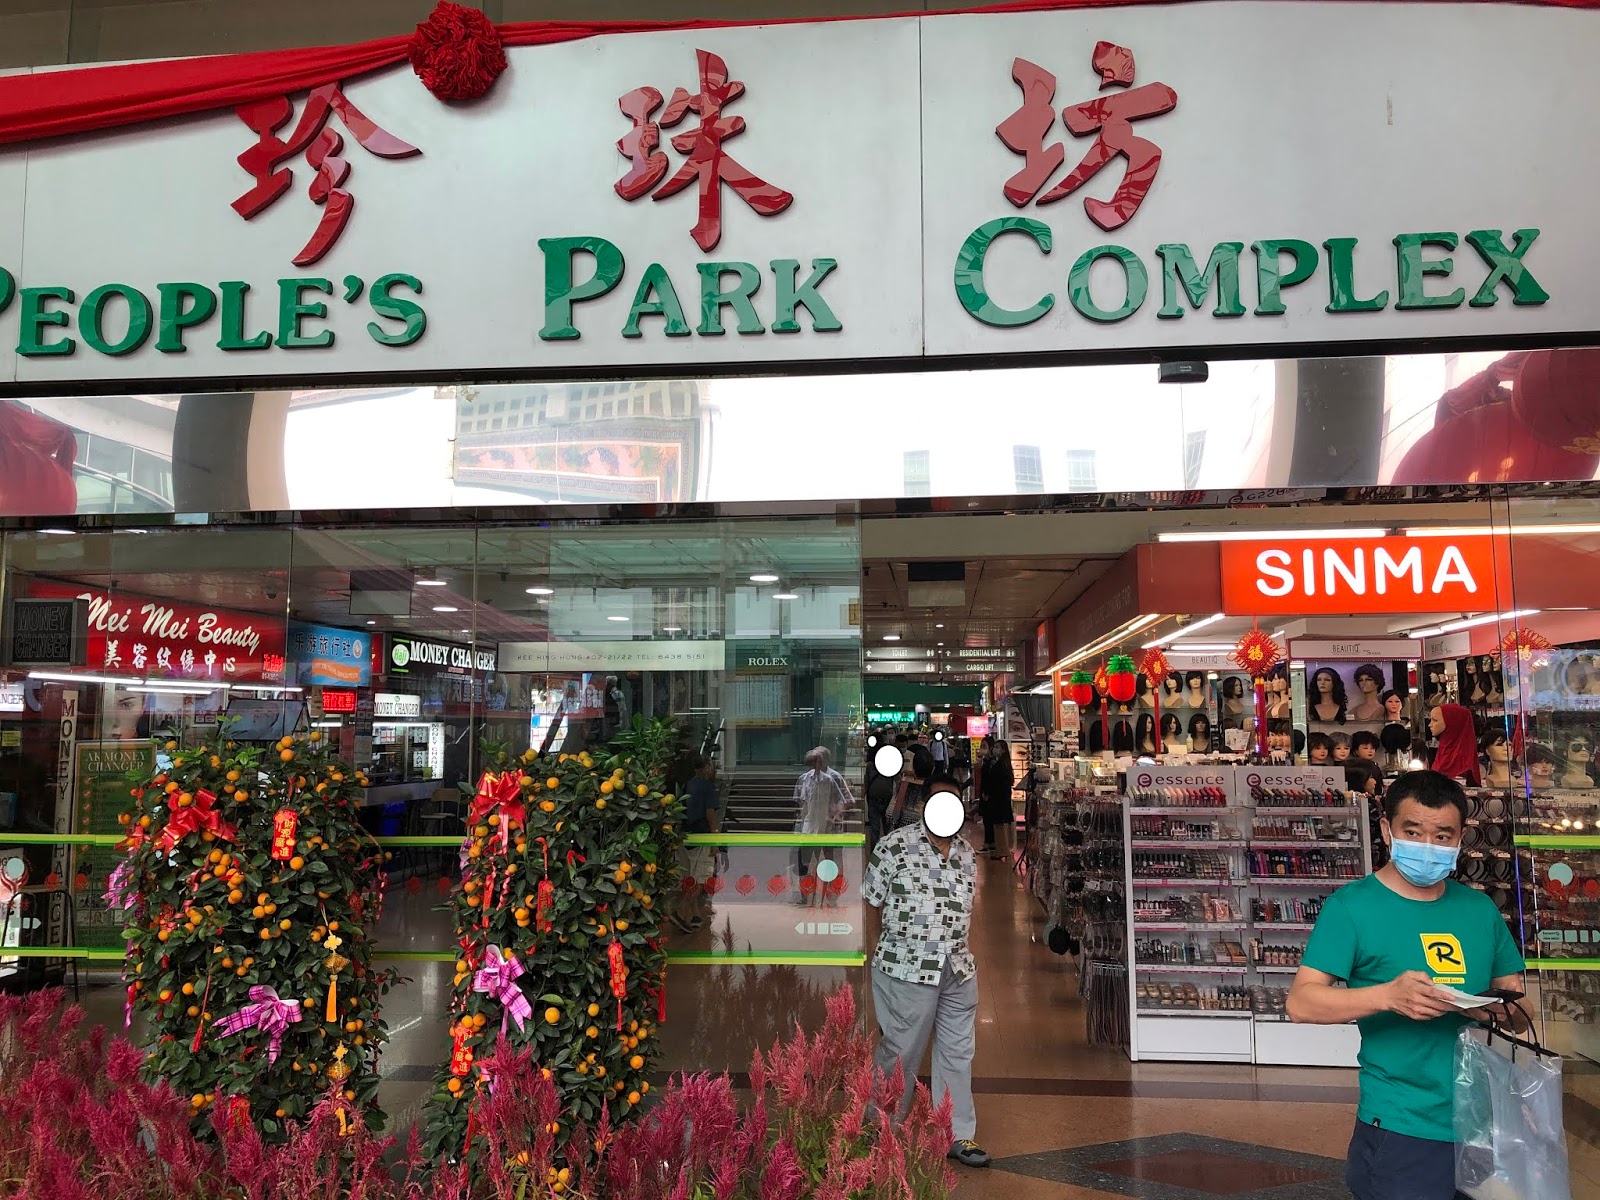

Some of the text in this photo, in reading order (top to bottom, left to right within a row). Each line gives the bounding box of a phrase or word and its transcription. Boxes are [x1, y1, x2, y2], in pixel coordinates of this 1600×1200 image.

[0, 216, 1551, 358] EOPLE'S PARK COMPLEX
[1255, 545, 1478, 597] SINMA
[17, 606, 69, 631] MONEY
[76, 592, 260, 657] Mei Mei Beauty
[15, 633, 69, 658] CHANGER
[410, 640, 450, 665] MONEY
[517, 653, 533, 661] KEE
[959, 648, 1001, 657] RESIDENTIAL LIFT
[748, 657, 788, 666] ROLEX
[374, 702, 419, 715] MONEY CHANGER
[59, 698, 76, 800] MONEY
[86, 751, 147, 761] AK MONEY
[1155, 774, 1224, 785] essence
[1264, 774, 1334, 785] essee
[1428, 941, 1461, 965] R
